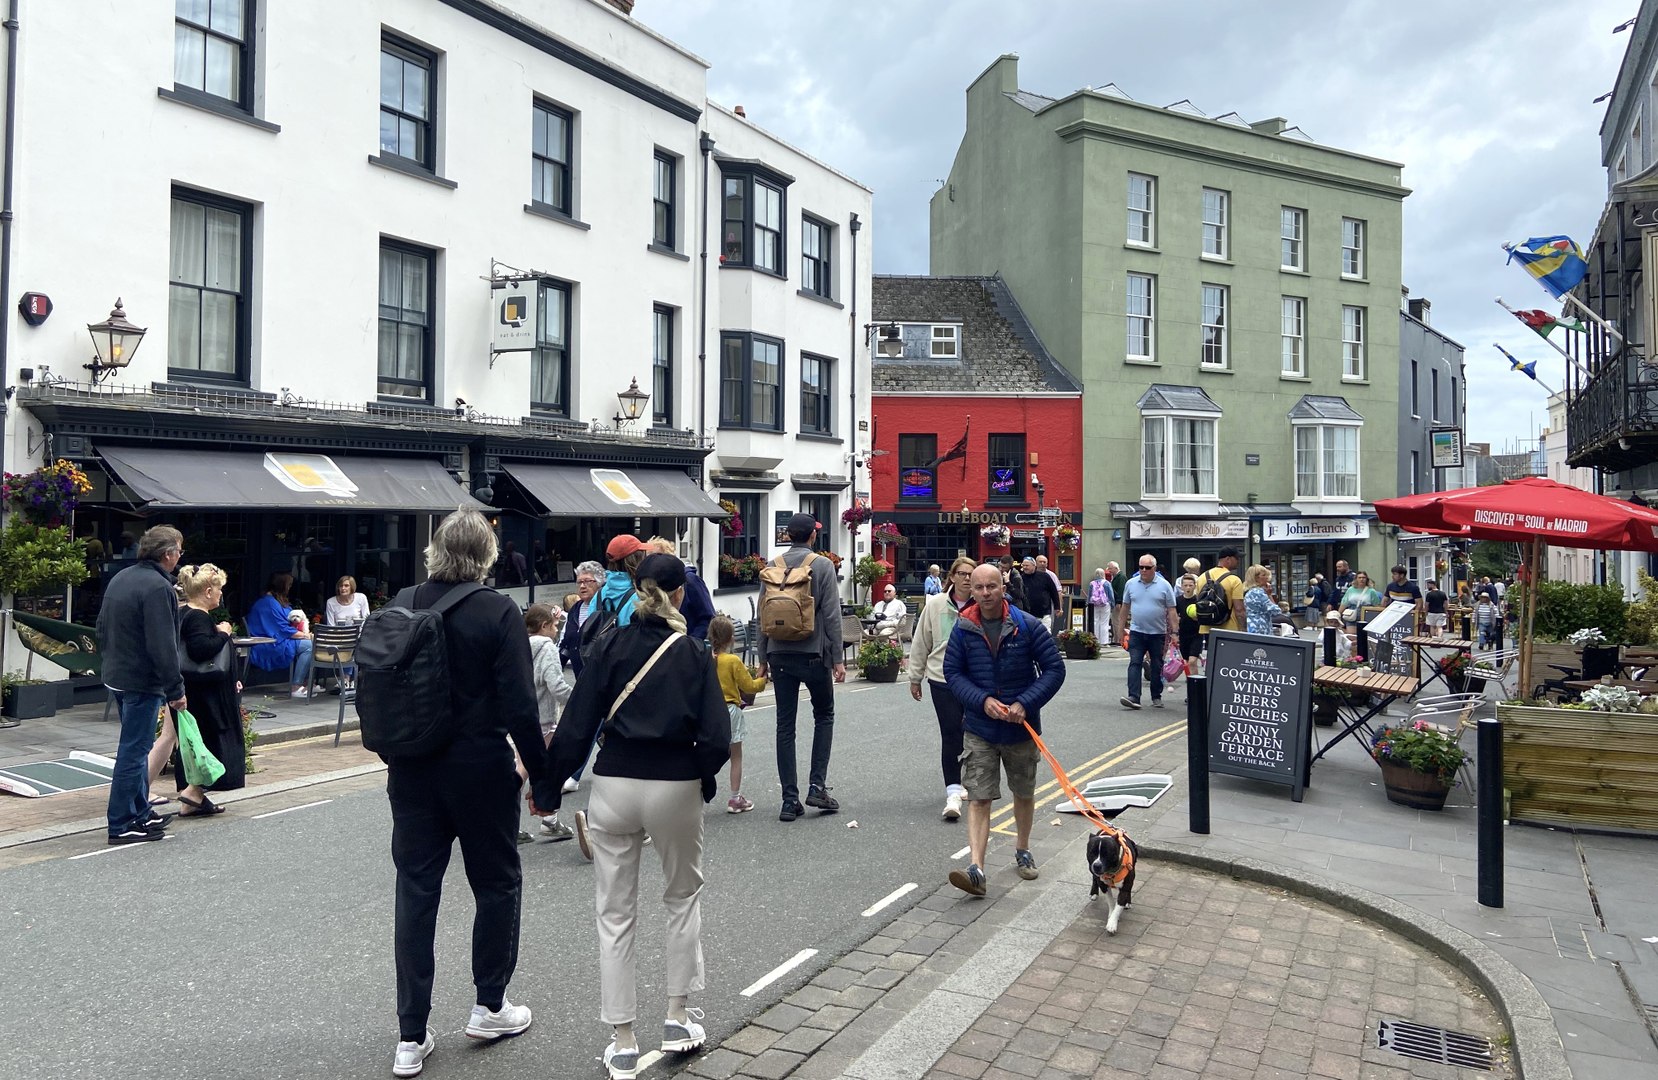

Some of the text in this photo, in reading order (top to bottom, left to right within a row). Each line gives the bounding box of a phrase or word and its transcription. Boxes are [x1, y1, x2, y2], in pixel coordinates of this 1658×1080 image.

[938, 512, 1009, 524] LIFEBOAT
[1474, 509, 1588, 533] DISCOVER THE SOUL OF MADRID
[1160, 523, 1220, 537] The Sinking Ship
[1286, 522, 1348, 537] John Francis
[1244, 658, 1275, 667] BAYTREE
[1220, 667, 1297, 686] COCKTAILS
[1232, 680, 1281, 697] WINES
[1233, 692, 1278, 709] BEERS
[1221, 703, 1288, 723] LUNCHES
[1228, 721, 1280, 739] SUNNY
[1221, 731, 1283, 750] GARDEN
[1218, 741, 1285, 762] TERRACE
[1243, 757, 1257, 765] THE
[1258, 760, 1276, 768] BACK
